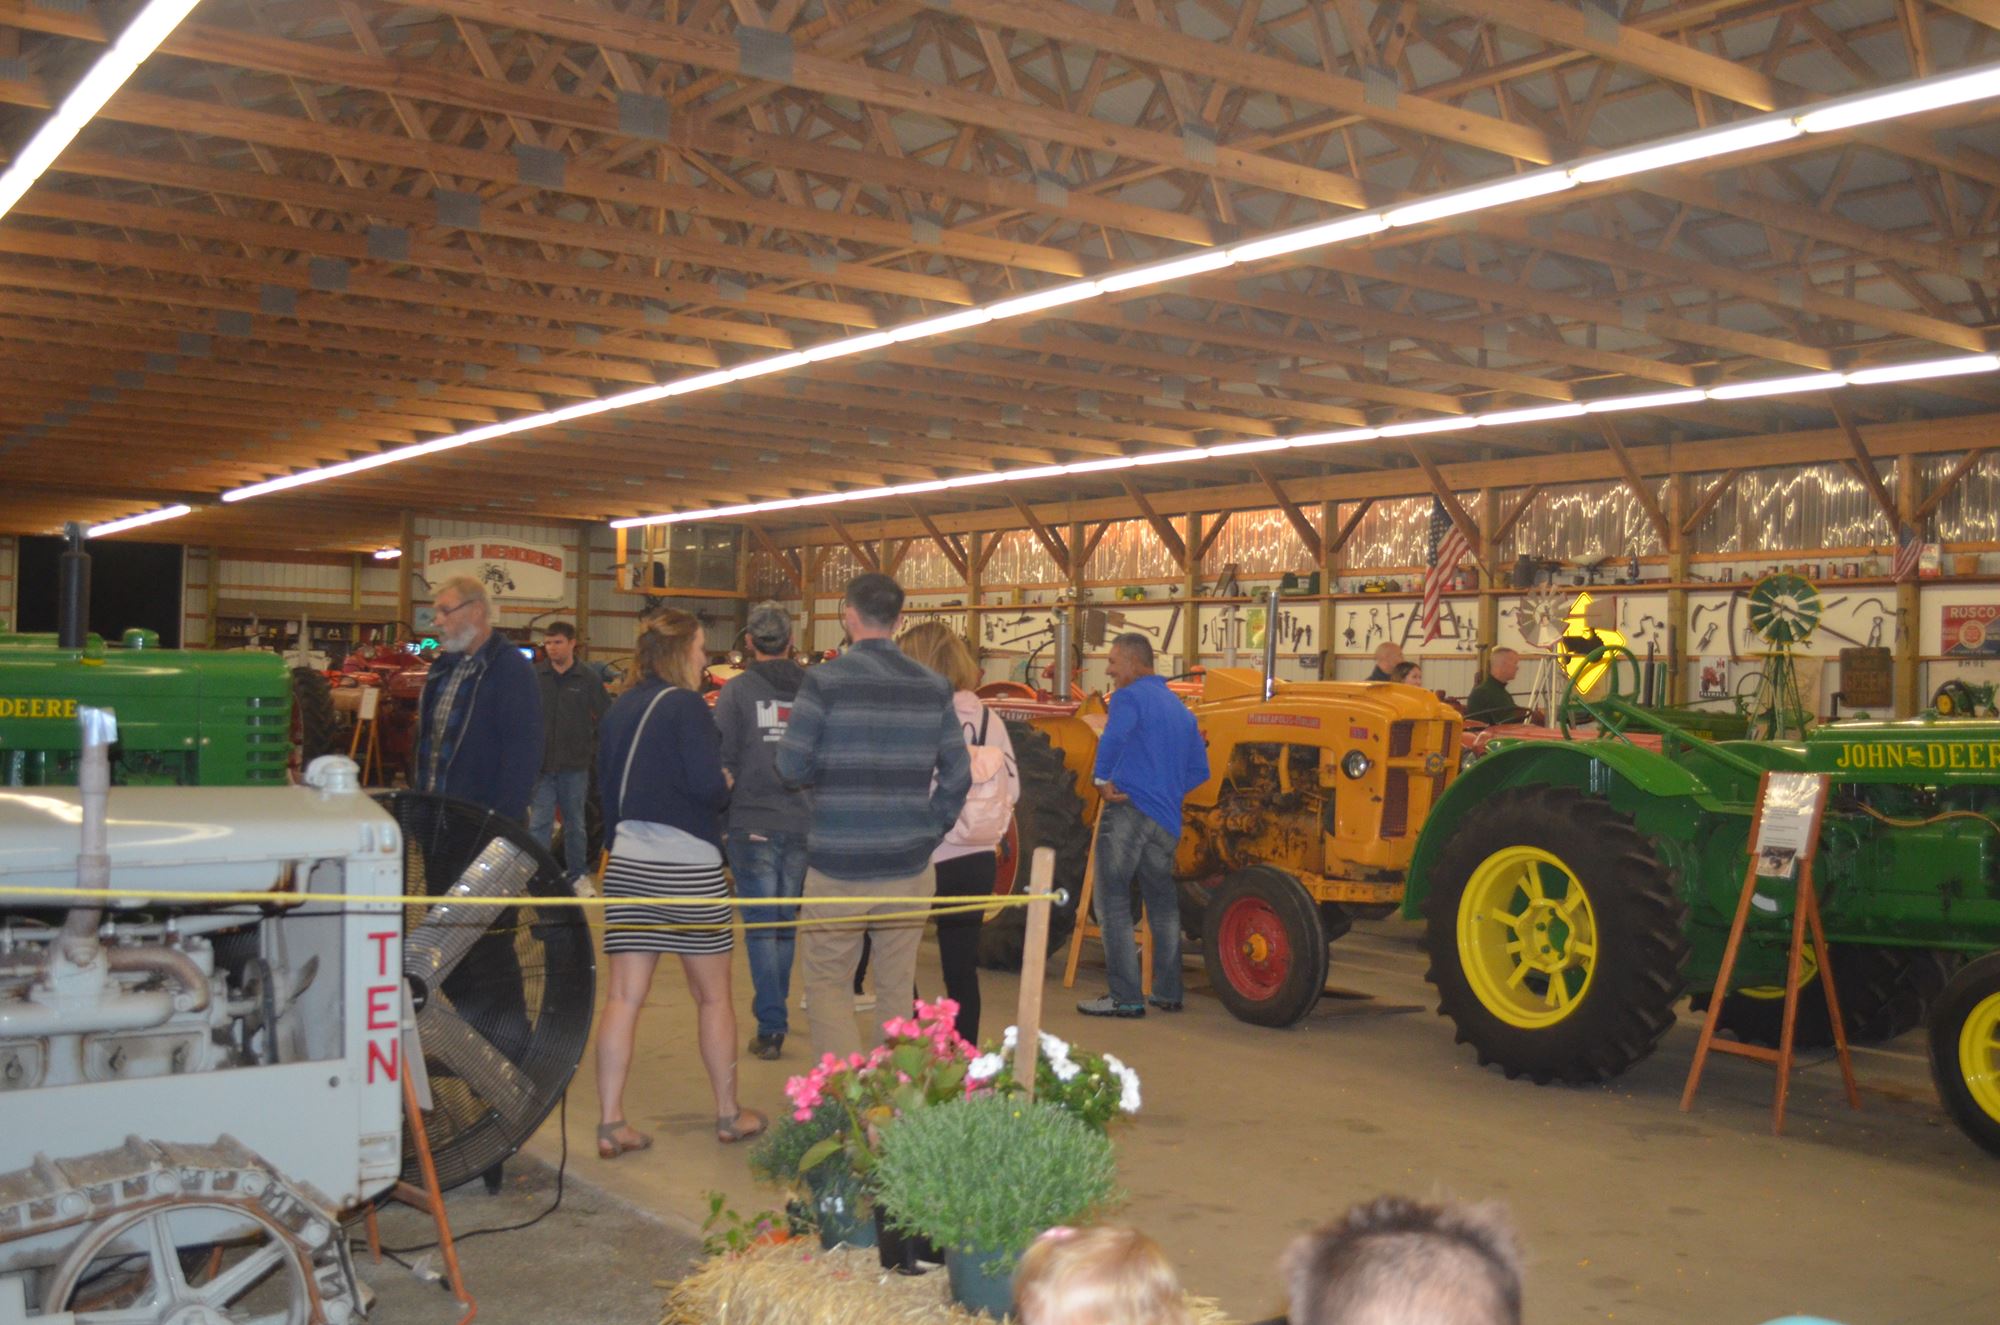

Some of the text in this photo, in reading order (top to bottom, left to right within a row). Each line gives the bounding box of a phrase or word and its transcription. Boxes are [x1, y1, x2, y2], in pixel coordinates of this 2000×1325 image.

[429, 544, 475, 565] FARM
[0, 698, 78, 718] DEERE
[1836, 743, 1904, 768] JOHN
[367, 931, 399, 1084] TEN
